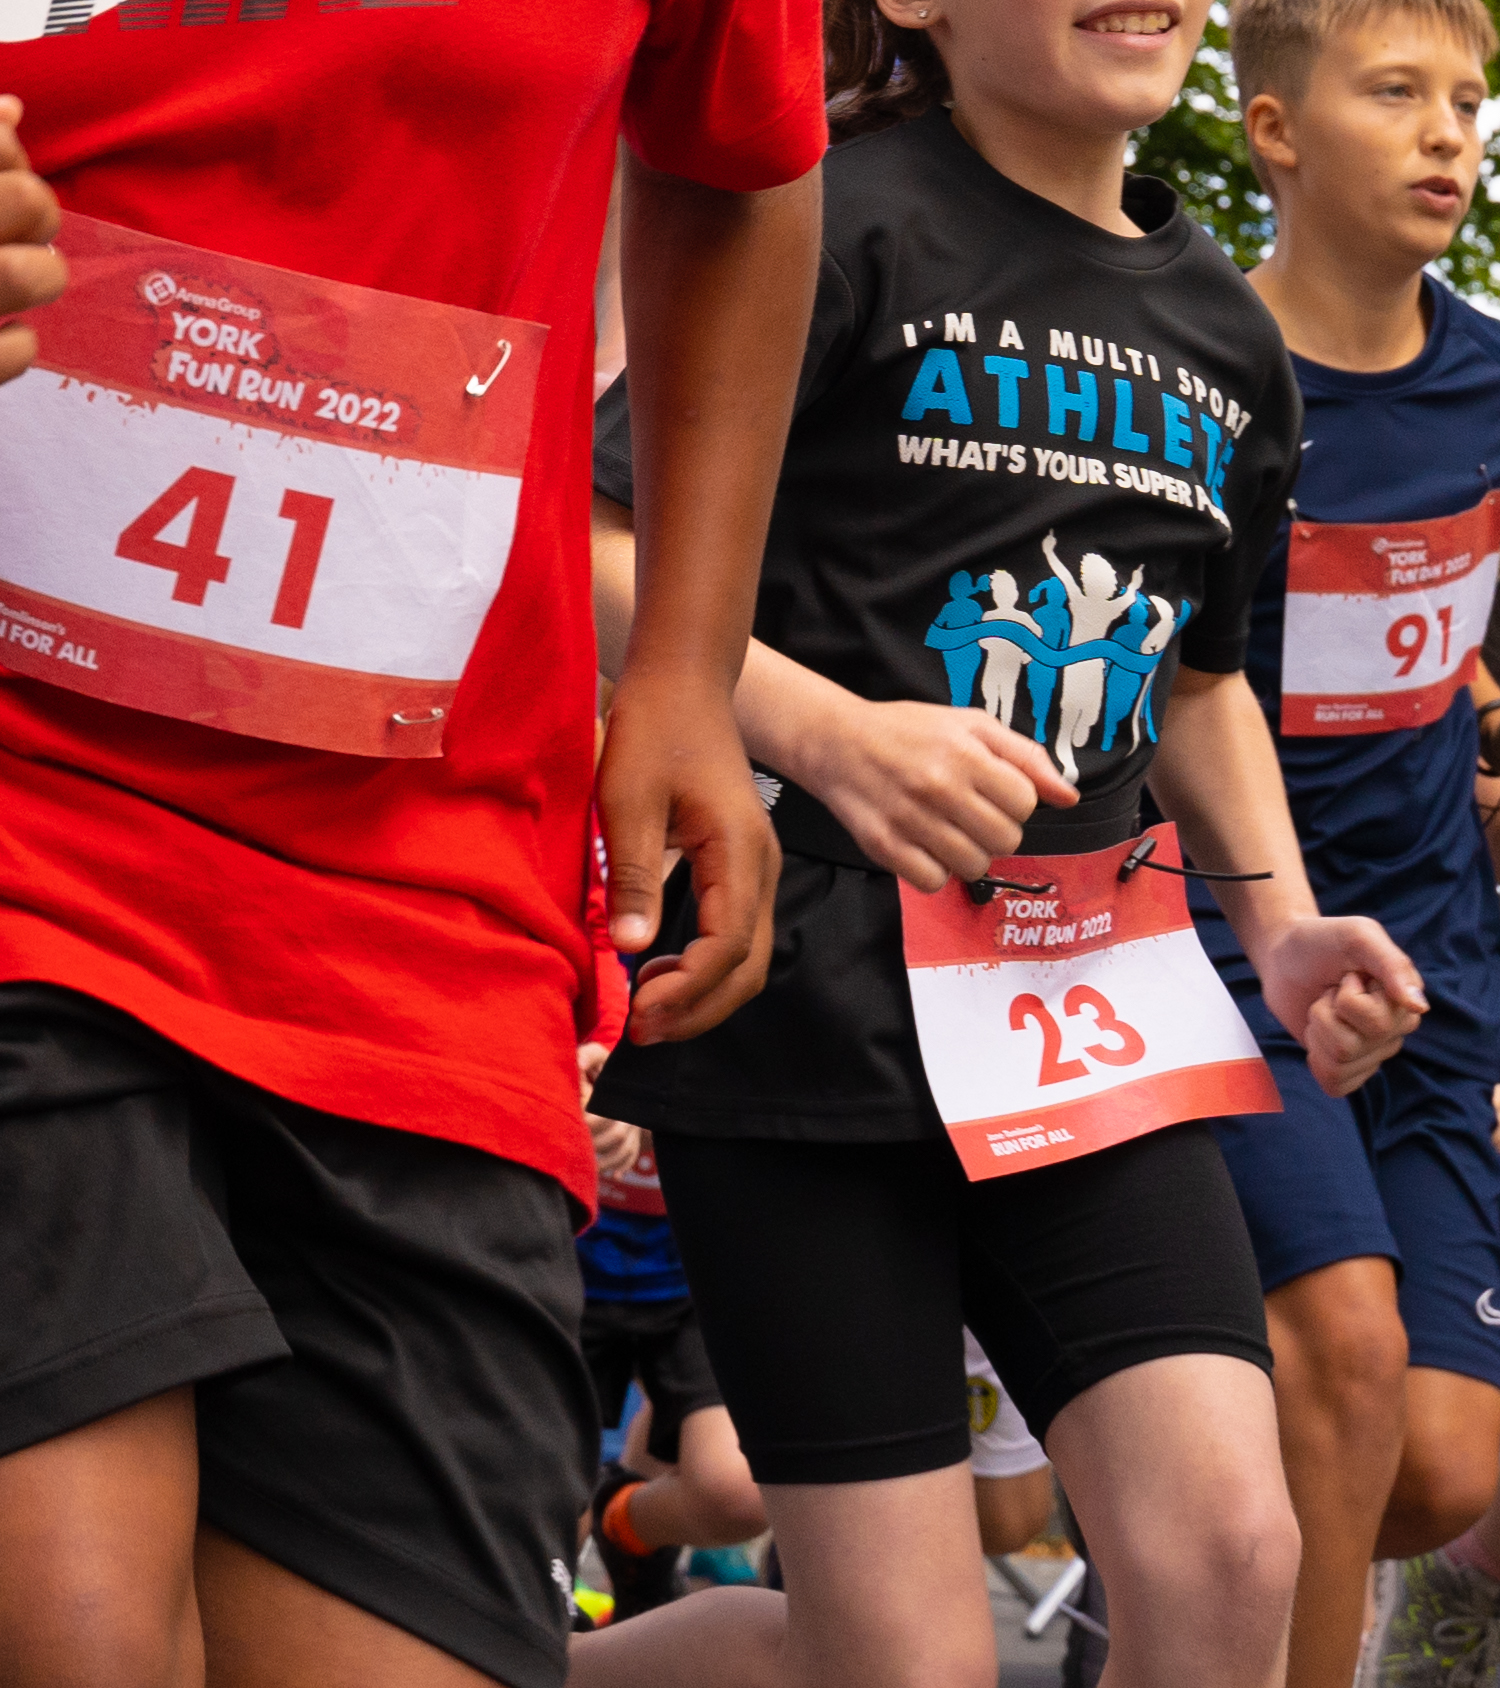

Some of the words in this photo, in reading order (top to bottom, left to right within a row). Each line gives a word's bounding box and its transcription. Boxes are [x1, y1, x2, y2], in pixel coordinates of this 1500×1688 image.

[172, 311, 266, 360] YORK
[167, 350, 235, 395] FUN
[236, 368, 305, 412] RUN
[315, 388, 401, 433] 2022
[903, 313, 976, 347] I'M
[999, 320, 1024, 349] A
[1049, 329, 1161, 381] MULTI
[1177, 367, 1252, 439] SPORT
[898, 434, 1027, 473] WHAT'S
[1033, 447, 1109, 485] YOUR
[1112, 463, 1194, 508] SUPER
[114, 464, 335, 631] 41
[8, 623, 55, 656] FOR
[56, 641, 99, 672] ALL
[1385, 604, 1454, 679] 91
[1002, 923, 1043, 946] FUN
[1043, 922, 1077, 946] RUN
[1080, 911, 1112, 940] 2022
[1004, 899, 1060, 918] YORK
[1008, 984, 1146, 1087] 23
[990, 1139, 1023, 1157] RUN
[1017, 1133, 1049, 1151] FOR
[1047, 1127, 1076, 1144] ALL
